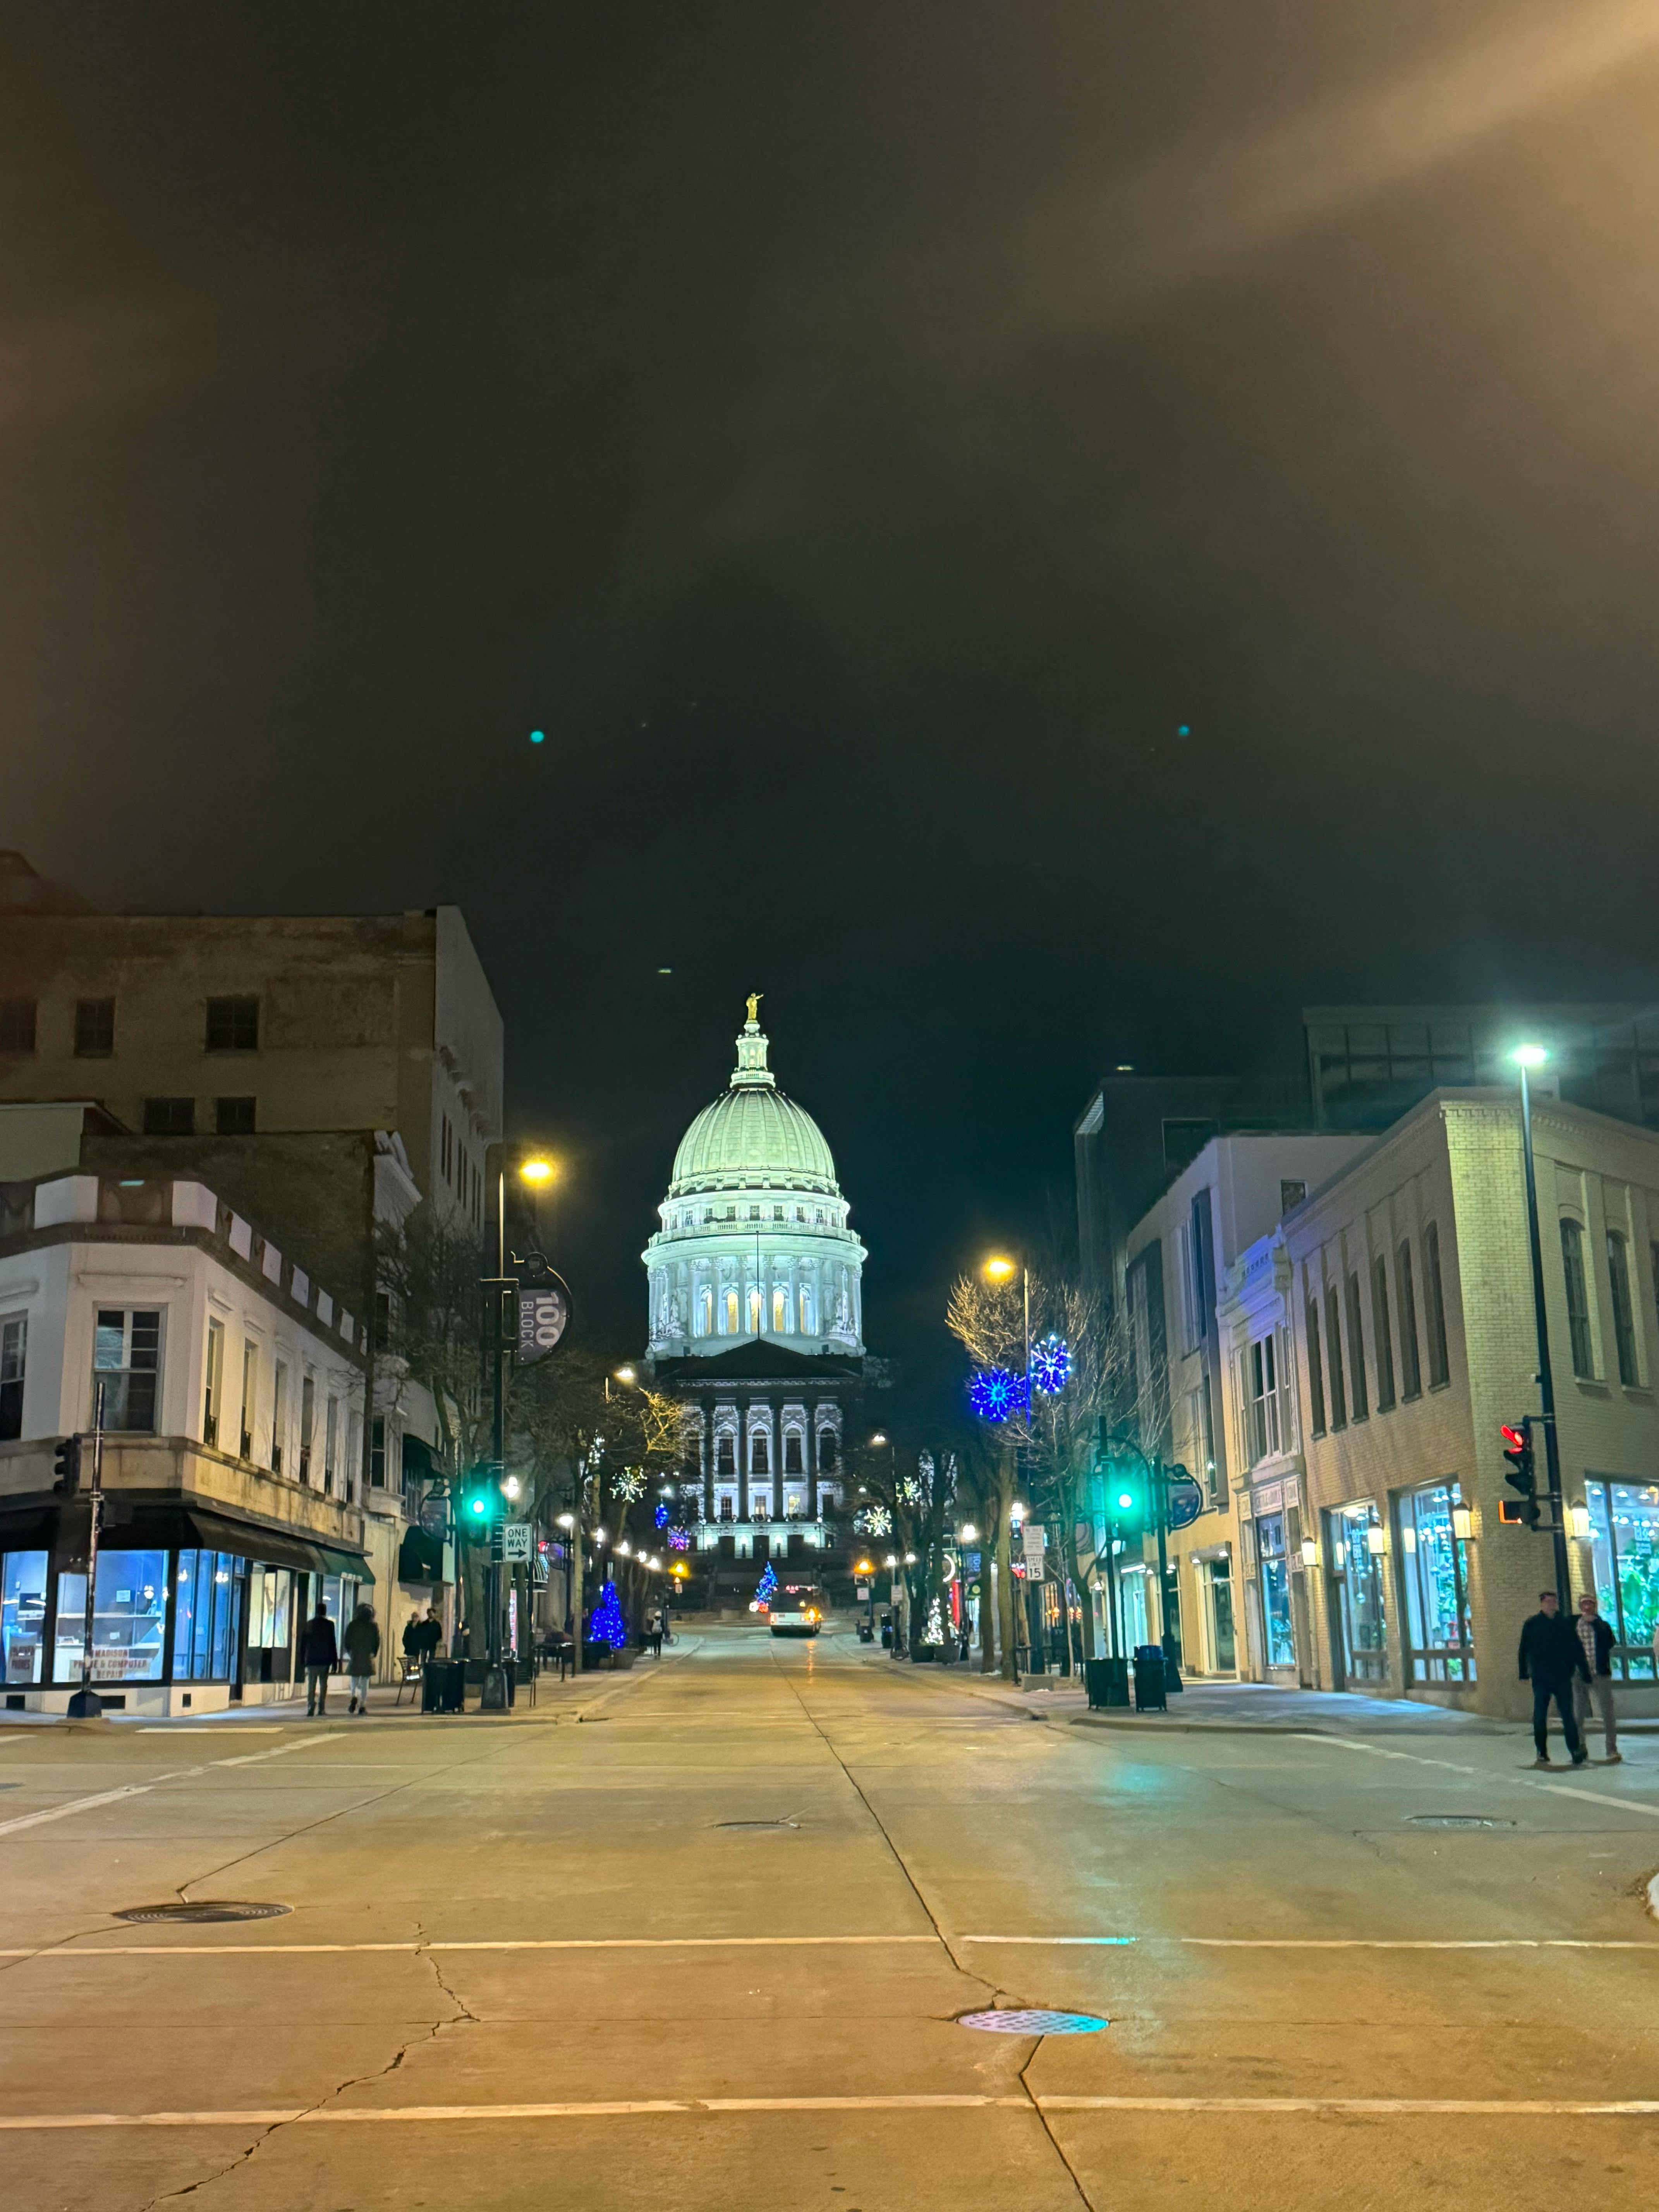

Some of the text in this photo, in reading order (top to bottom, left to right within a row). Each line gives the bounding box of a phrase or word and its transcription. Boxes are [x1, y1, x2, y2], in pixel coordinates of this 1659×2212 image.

[536, 1292, 559, 1346] 100
[520, 1302, 534, 1348] BLOCK
[508, 1528, 527, 1537] ONE
[508, 1539, 527, 1547] WAY
[1030, 1568, 1041, 1578] 15
[95, 1649, 128, 1657] MADISON
[74, 1660, 98, 1669] PHNE
[108, 1659, 147, 1668] COMPUTER
[96, 1670, 123, 1679] REPAIR
